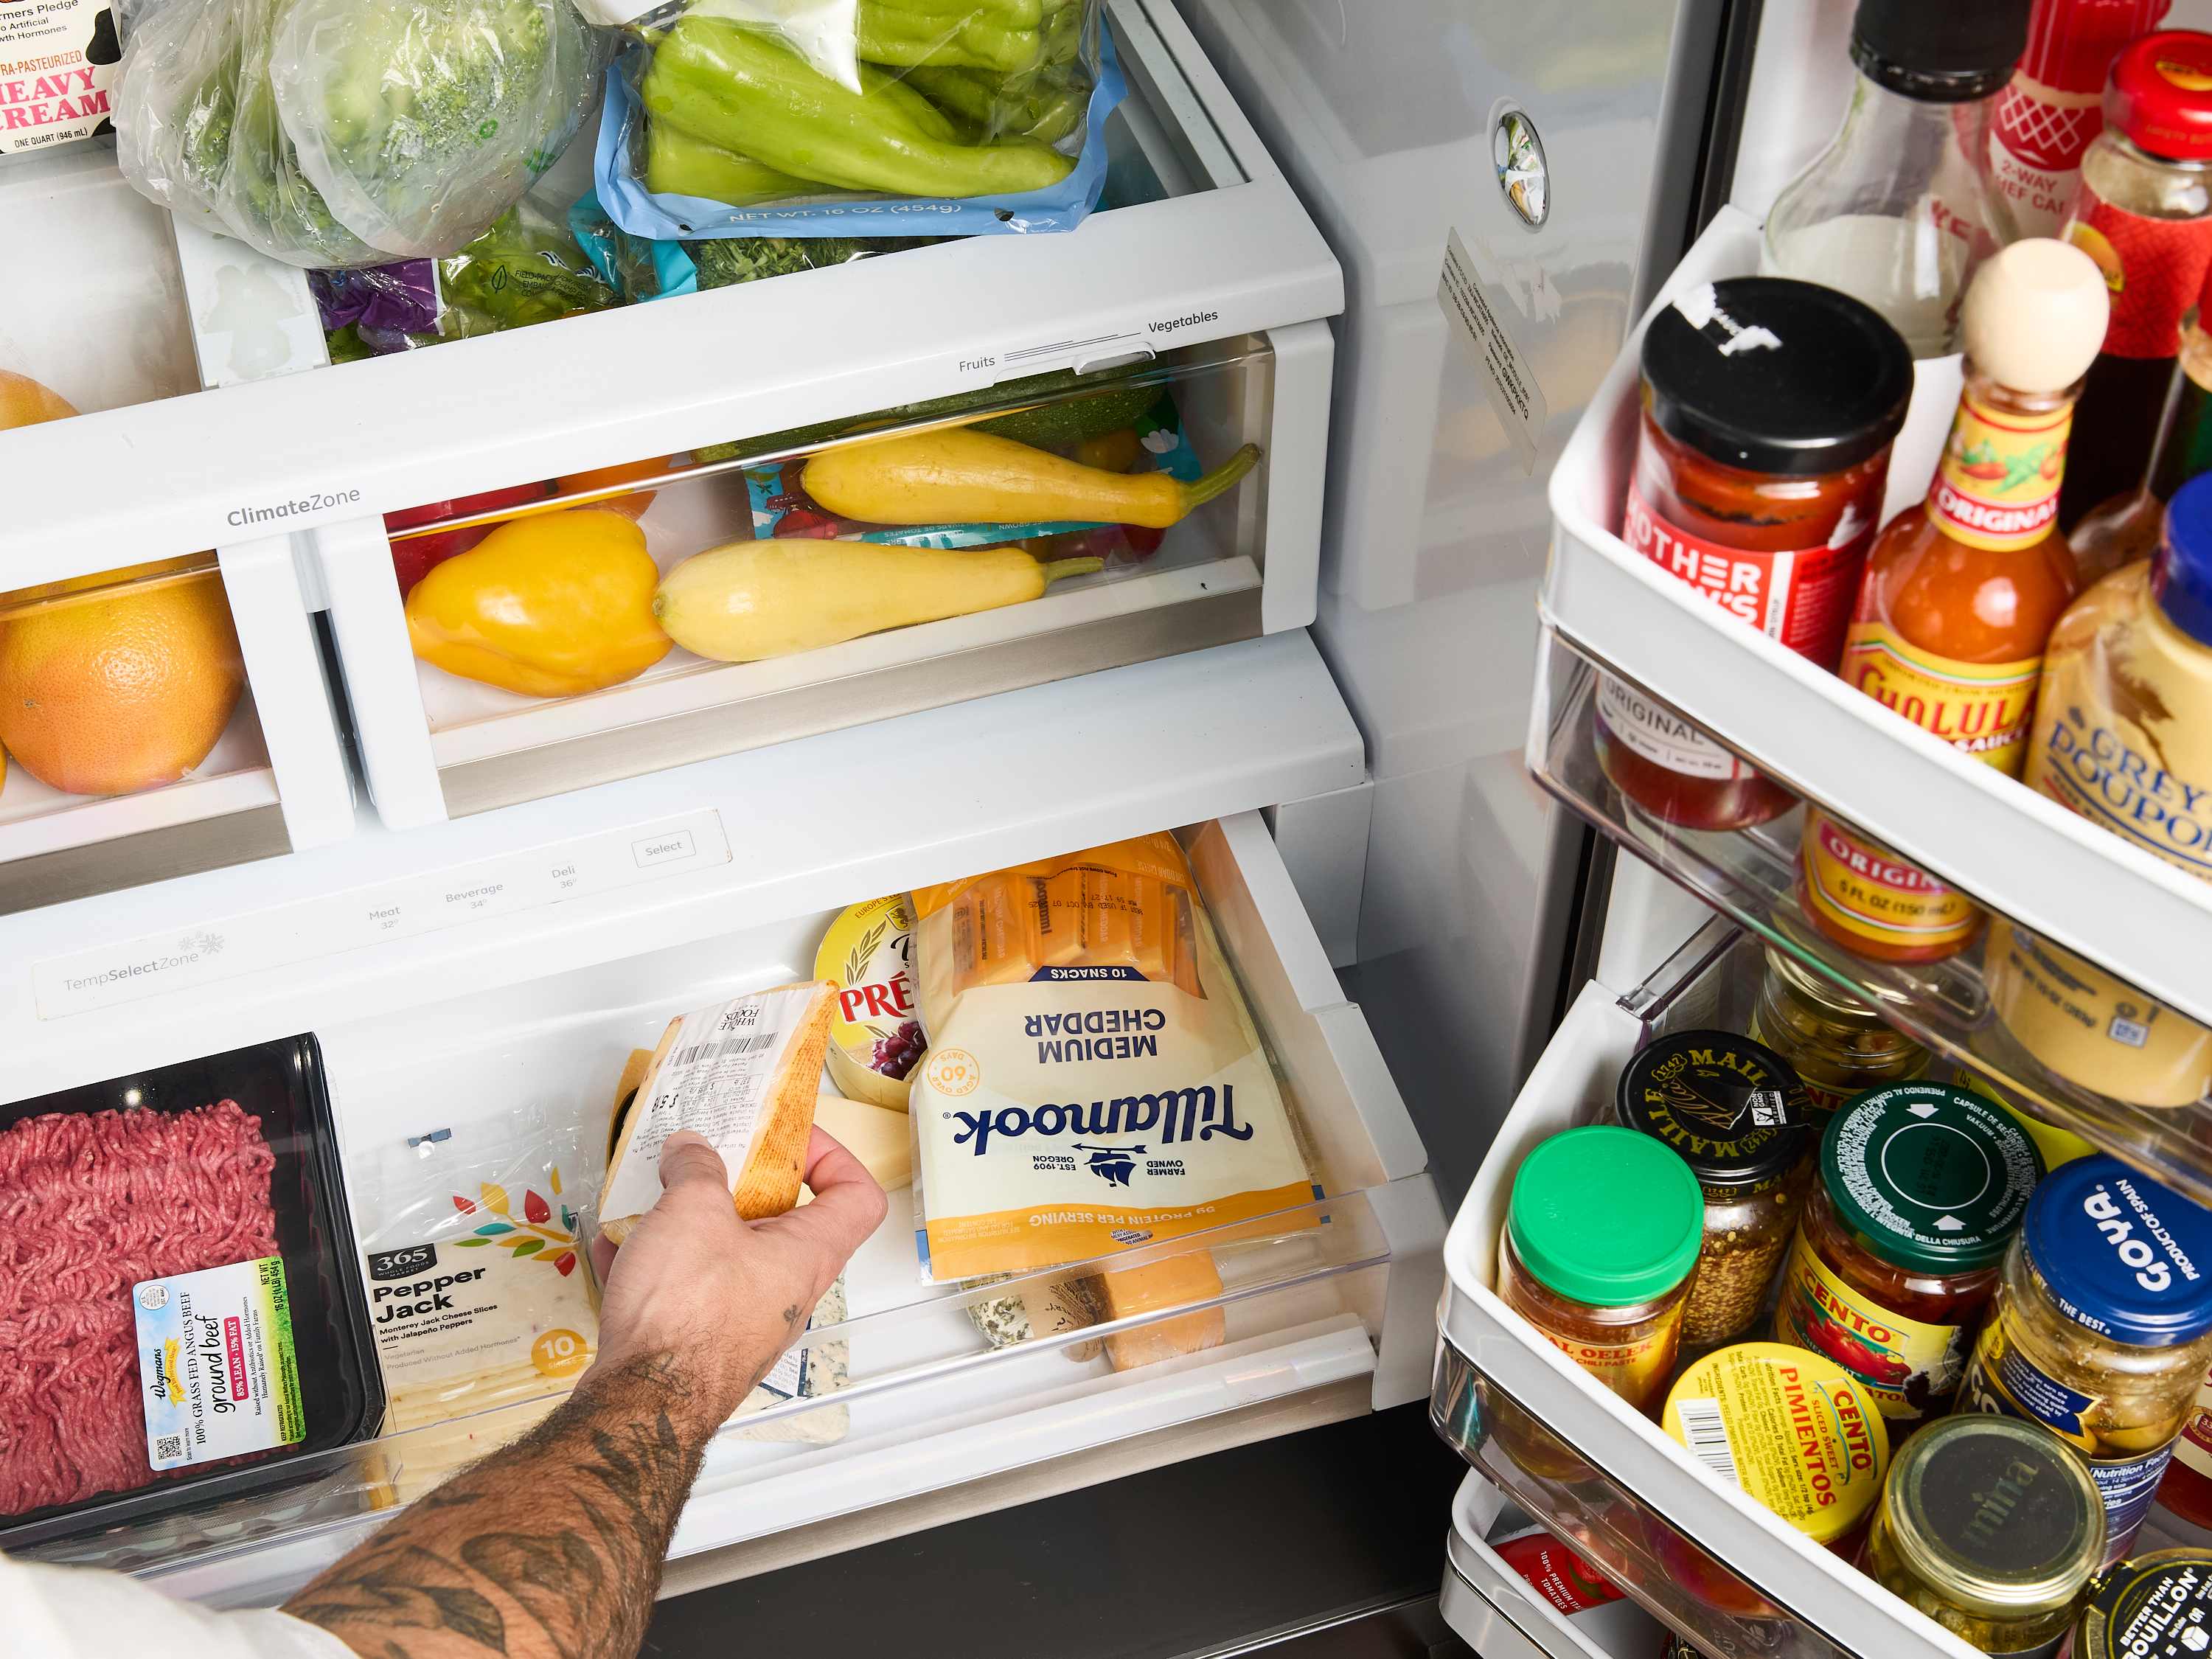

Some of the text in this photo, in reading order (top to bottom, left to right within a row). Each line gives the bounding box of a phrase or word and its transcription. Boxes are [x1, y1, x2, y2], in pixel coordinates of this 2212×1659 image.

[37, 0, 79, 14] Pledge
[10, 17, 49, 30] Artificial
[18, 24, 67, 40] Hormones
[0, 89, 111, 131] REAM
[15, 126, 88, 148] ONE QUART (946 mL)
[2002, 159, 2057, 192] 2-WAY
[729, 212, 772, 222] NET
[776, 210, 816, 219] WT.
[891, 203, 962, 215] (454g)
[1148, 310, 1219, 333] Vegetables
[959, 355, 996, 373] Fruits
[227, 486, 361, 528] ClimateZone
[2090, 727, 2205, 812] GREY
[644, 838, 684, 857] Select
[551, 864, 576, 880] Deli
[445, 882, 504, 905] Beverage
[1067, 900, 1080, 908] OCT
[1848, 885, 1868, 903] FL
[1869, 894, 1890, 911] OZ
[369, 905, 402, 922] Meat
[1098, 902, 1117, 910] USED
[63, 948, 200, 992] TempSelectZone
[1050, 966, 1128, 980] 10 SNACKS
[718, 1018, 755, 1032] WHOLE
[725, 1009, 759, 1022] FOODS
[1026, 1009, 1166, 1037] CHEDDAR
[940, 1052, 964, 1062] DAYS
[1038, 1034, 1158, 1064] MEDIUM
[932, 1074, 977, 1095] AGED OVER
[941, 1065, 966, 1082] 60
[1891, 1088, 1904, 1096] AL
[1903, 1086, 1945, 1096] PREMENDO
[953, 1084, 1253, 1156] Tillamook
[1952, 1096, 2000, 1125] CAPSULE DE
[1964, 1113, 1996, 1137] VAKUUM
[1147, 1159, 1183, 1168] OWNED
[1147, 1168, 1186, 1177] FARMER
[1029, 1211, 1094, 1227] SERVING
[1097, 1213, 1125, 1224] PER
[1129, 1210, 1194, 1225] PROTEIN
[1914, 1234, 1941, 1245] DELLA
[1941, 1235, 1982, 1245] CHIUSURA
[2083, 1190, 2172, 1293] GOYA
[2115, 1179, 2201, 1282] PRODUCT OF SPAIN
[377, 1247, 428, 1272] 365
[378, 1261, 430, 1276] WHOLE FOODS
[259, 1264, 270, 1285] NET WT
[269, 1265, 280, 1277] 454
[389, 1267, 419, 1278] MARKET
[270, 1277, 282, 1288] LB)
[373, 1267, 486, 1303] Pepper
[273, 1295, 283, 1304] OZ
[274, 1303, 284, 1312] 16
[376, 1293, 454, 1324] Jack
[1804, 1266, 1892, 1343] CENTO
[243, 1296, 251, 1329] Hormones
[379, 1304, 498, 1336] Monterey Jack Cheese Slices
[2059, 1298, 2107, 1332] THE BEST
[255, 1327, 263, 1345] Family
[380, 1318, 473, 1343] with Jalapeño Peppers
[384, 1348, 425, 1360] Vegetarian
[386, 1358, 422, 1370] Produced
[423, 1353, 453, 1364] Without
[455, 1346, 479, 1357] Added
[540, 1335, 576, 1359] 10
[1580, 1340, 1653, 1360] OELEK
[180, 1292, 206, 1444] 100% GRASS FED ANGUS BEEF
[195, 1314, 236, 1414] ground beef
[228, 1321, 245, 1397] 85% LEAN 15% FAT
[248, 1349, 257, 1377] Antibiotics
[1604, 1357, 1637, 1368] PASTE
[150, 1348, 172, 1400] Wegmans
[254, 1399, 262, 1416] Raised
[276, 1404, 285, 1430] REFRIGERATED
[1767, 1408, 1781, 1435] Calories
[1833, 1390, 1874, 1472] CENTO
[1779, 1366, 1837, 1508] PIMIENTOS
[1811, 1399, 1840, 1470] SLICED SWEET
[2092, 1464, 2144, 1479] Nutrition
[1539, 1550, 1572, 1602] 100% PREMIUM
[1540, 1577, 1568, 1610] TOMATOES
[2119, 1576, 2174, 1647] BETTER THAN
